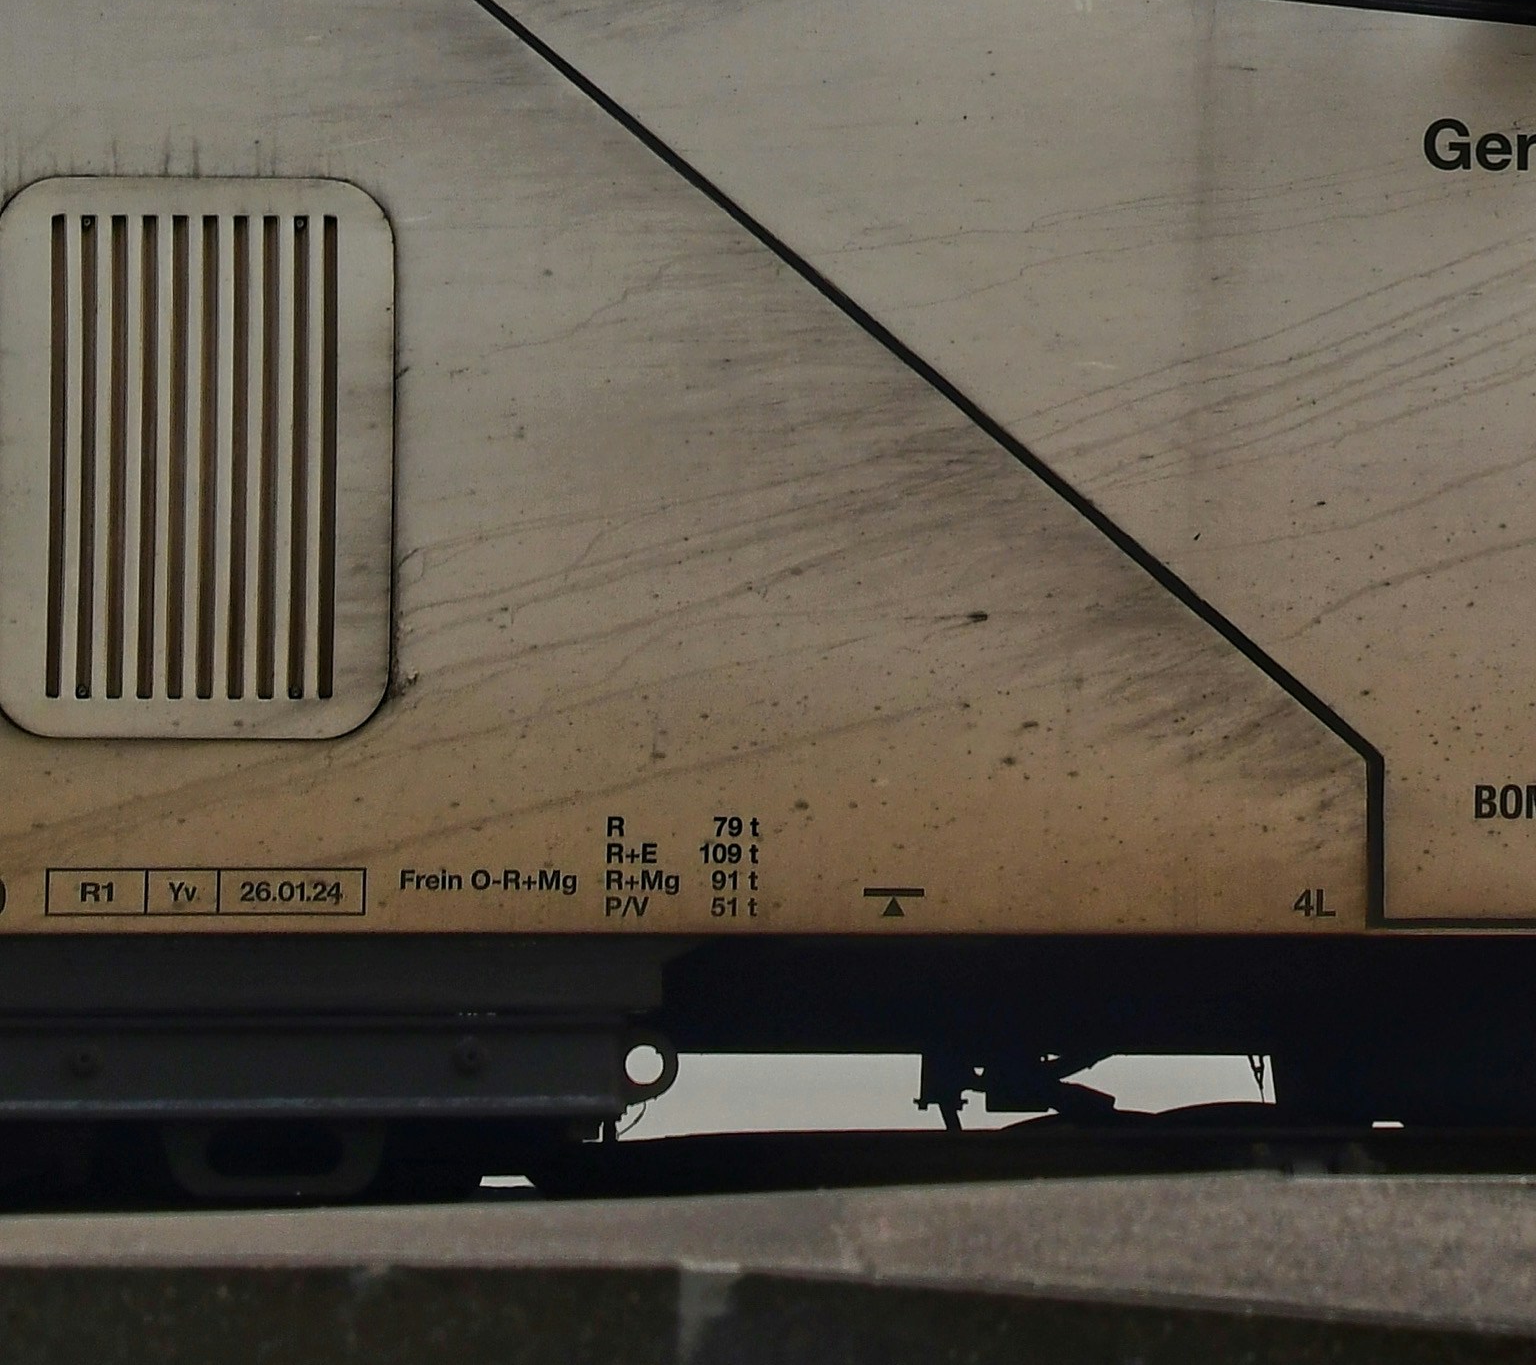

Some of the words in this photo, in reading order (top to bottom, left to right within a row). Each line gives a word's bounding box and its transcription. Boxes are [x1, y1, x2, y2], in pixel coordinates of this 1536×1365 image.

[606, 816, 625, 838] R
[713, 816, 743, 838] 79
[749, 817, 760, 838] t
[606, 842, 658, 865] R+E
[699, 842, 742, 865] 109
[748, 844, 759, 865] t
[80, 881, 114, 903] R1
[239, 880, 344, 905] 26.01.24
[400, 868, 463, 891] Frein
[471, 869, 577, 896] O-R+Mg
[606, 869, 680, 896] R+Mg
[711, 869, 738, 891] 91
[747, 870, 759, 891] t
[605, 895, 650, 918] P/V
[710, 896, 737, 917] 51
[747, 897, 758, 918] t
[1293, 888, 1337, 918] 4L
